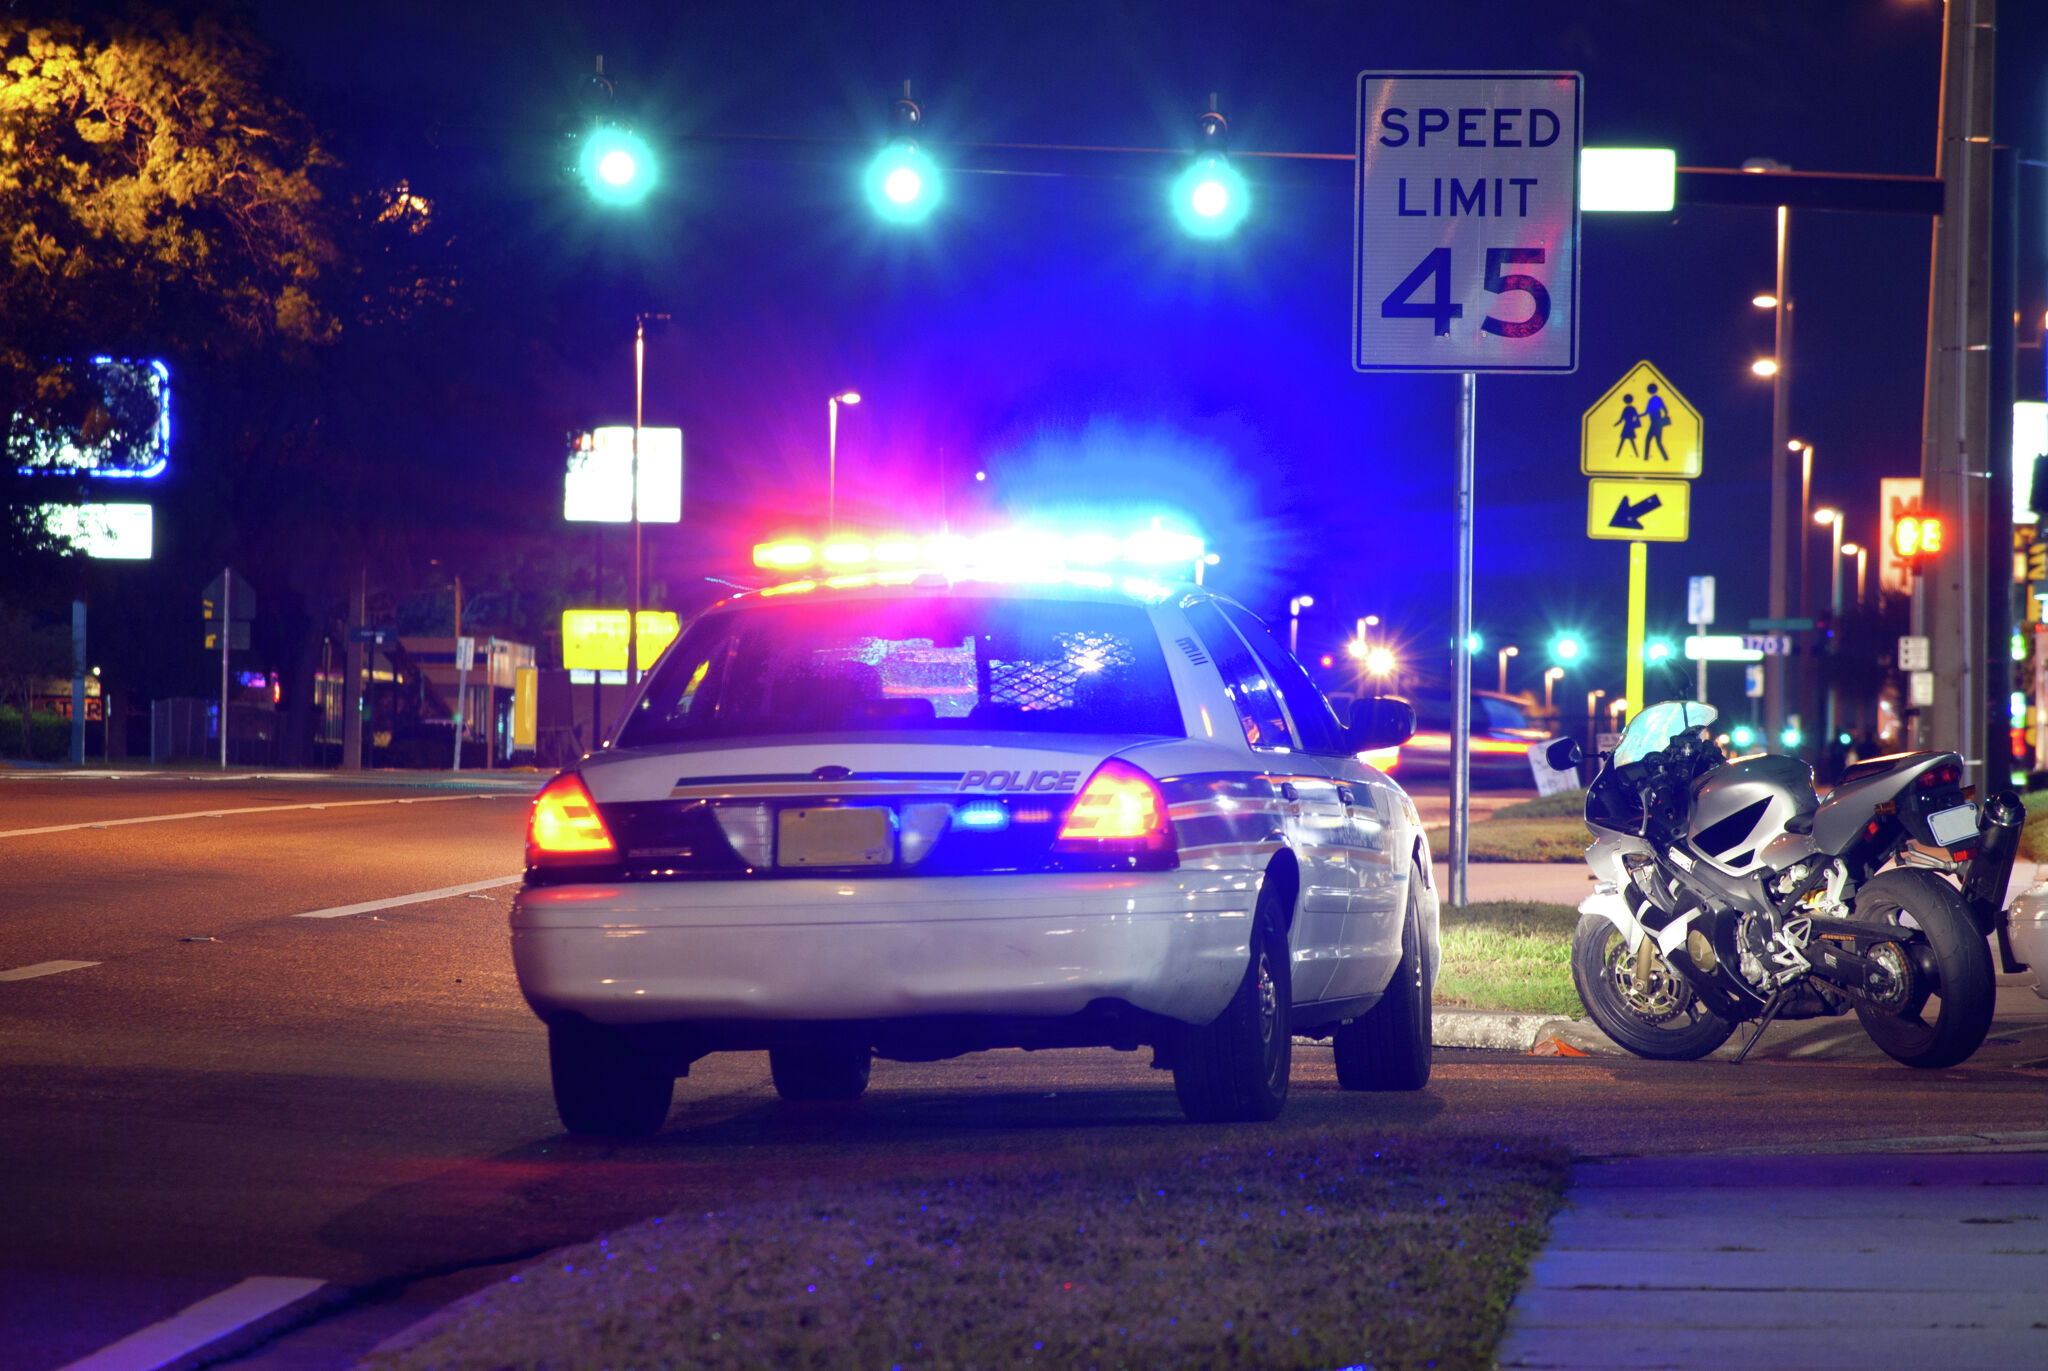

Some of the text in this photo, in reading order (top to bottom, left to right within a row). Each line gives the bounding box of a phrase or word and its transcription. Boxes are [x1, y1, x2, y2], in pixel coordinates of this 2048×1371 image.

[1379, 107, 1561, 148] SPEED
[1398, 177, 1538, 217] LIMIT
[1381, 247, 1551, 339] 45
[959, 770, 1081, 791] POLICE
